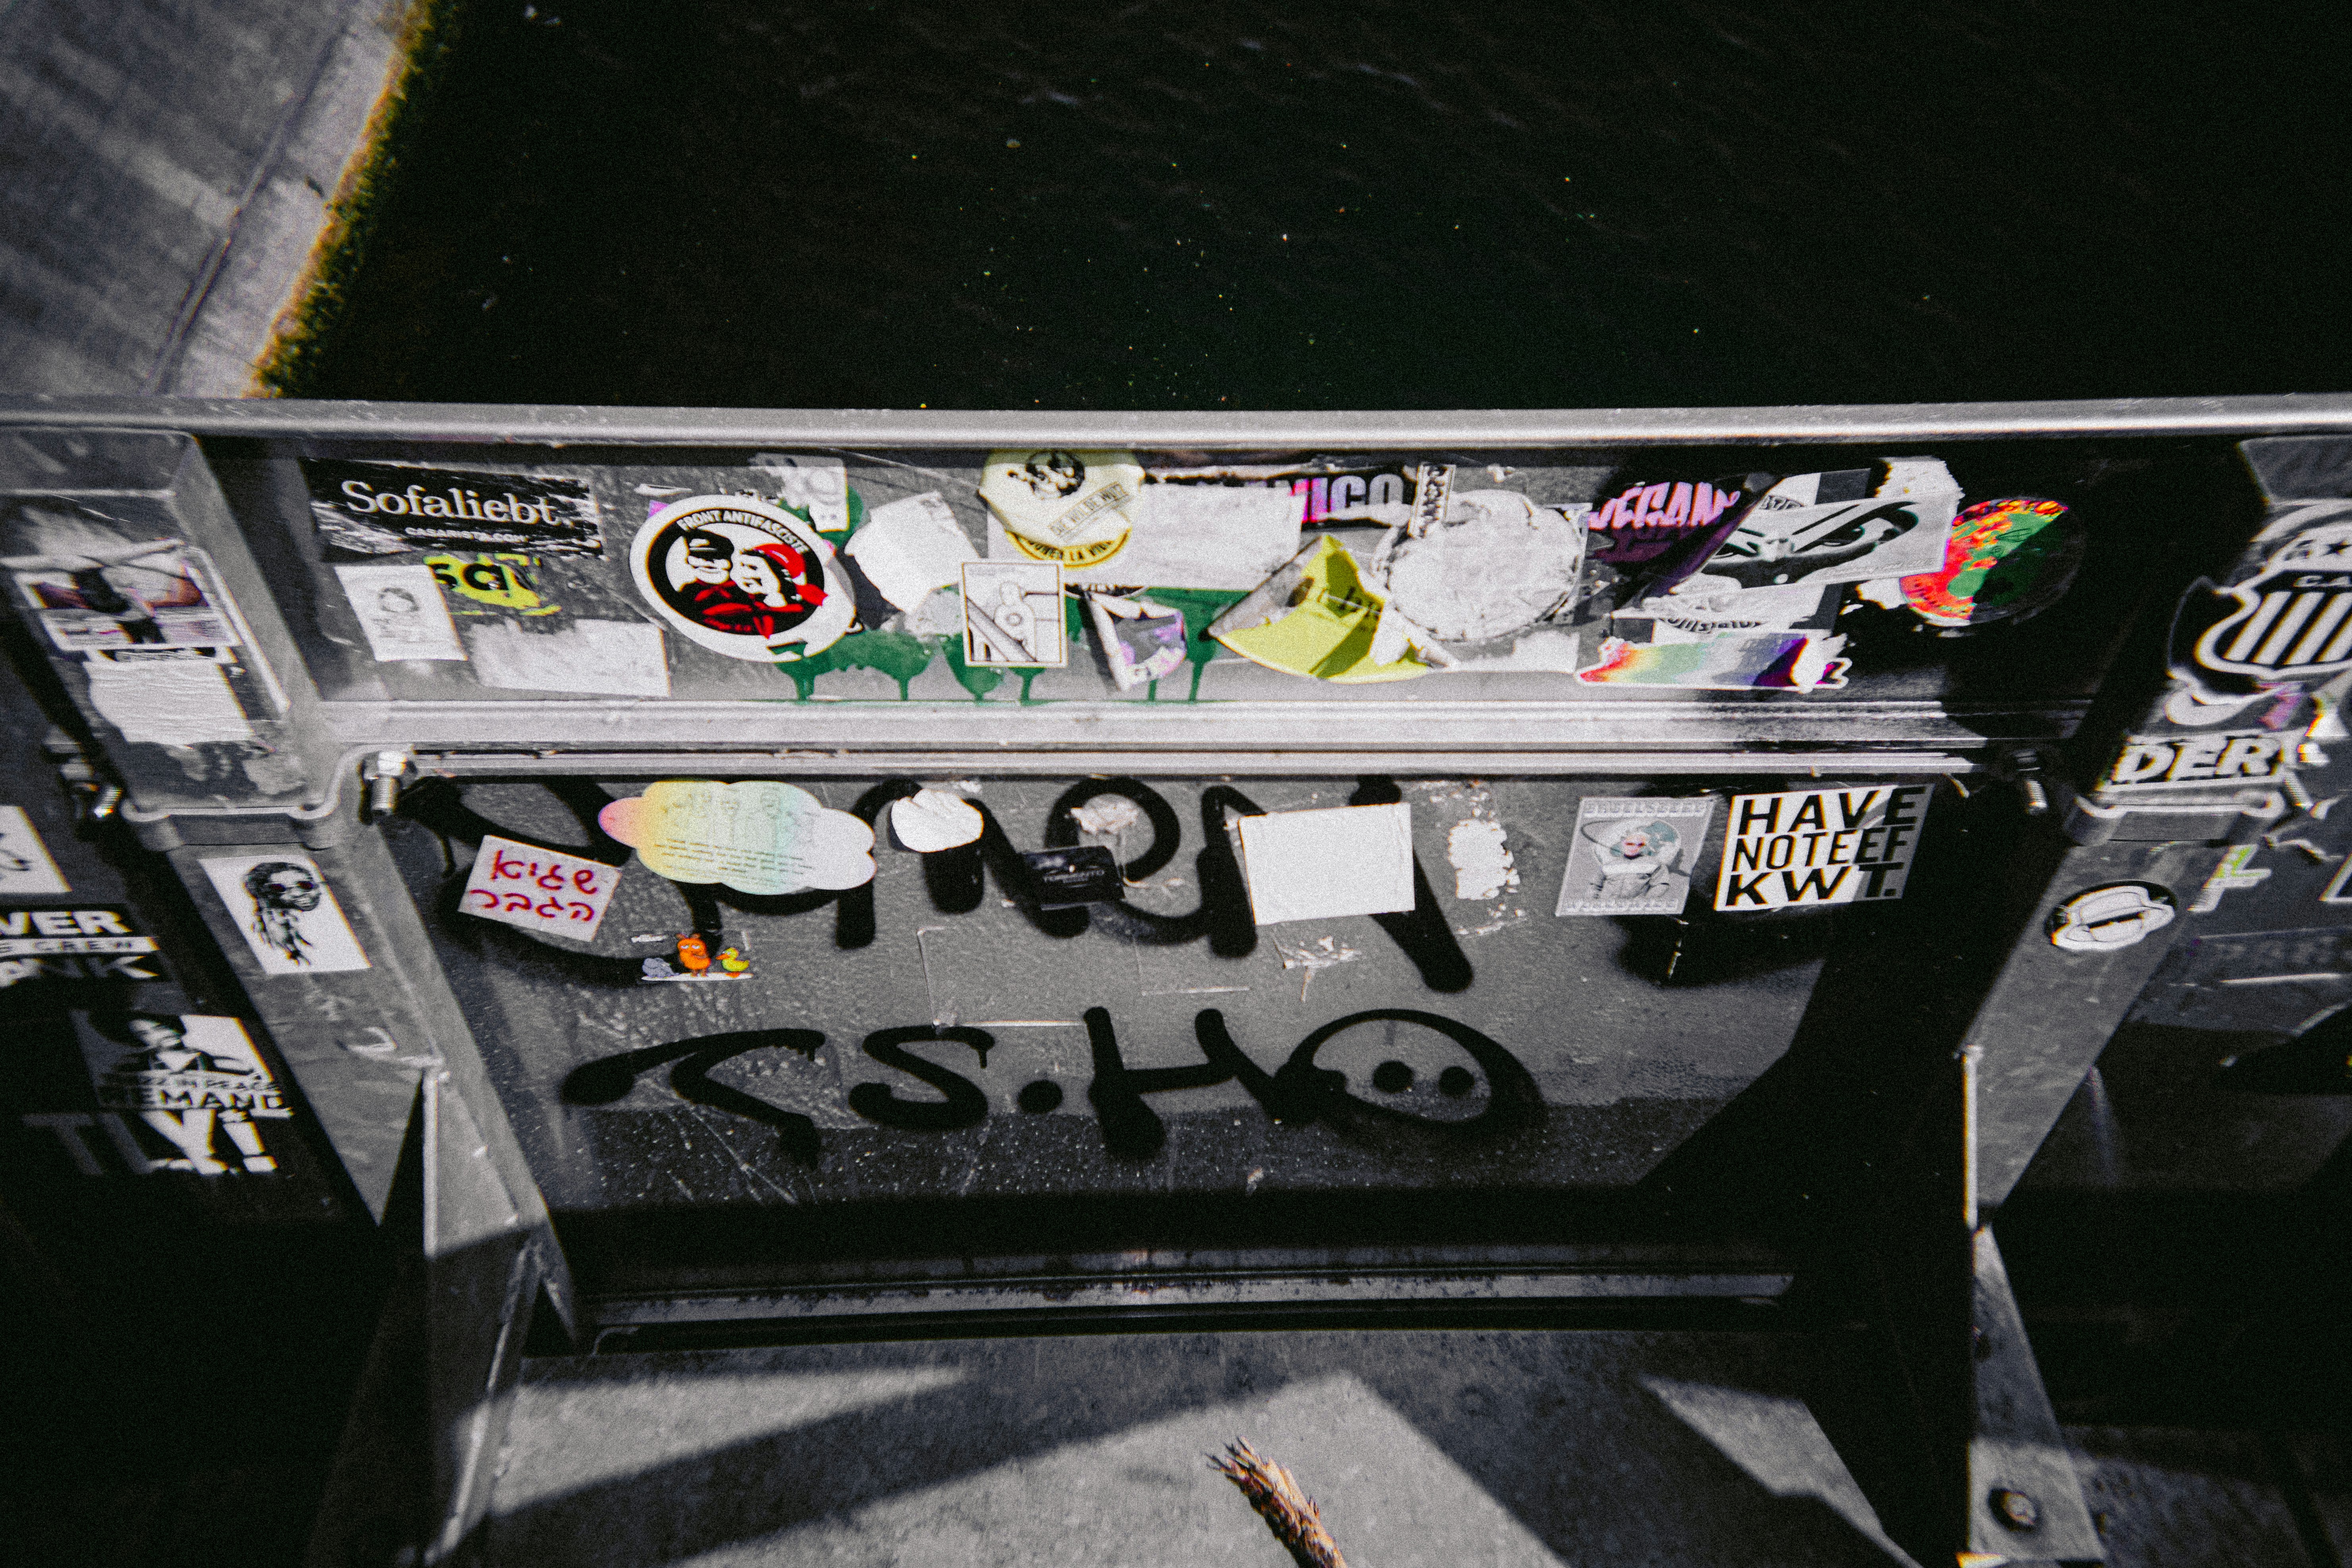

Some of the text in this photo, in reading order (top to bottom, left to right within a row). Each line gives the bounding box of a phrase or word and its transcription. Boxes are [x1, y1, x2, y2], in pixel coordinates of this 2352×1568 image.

[676, 510, 812, 554] FRONT ANTIFASCISTE
[1738, 785, 1928, 836] HAVE
